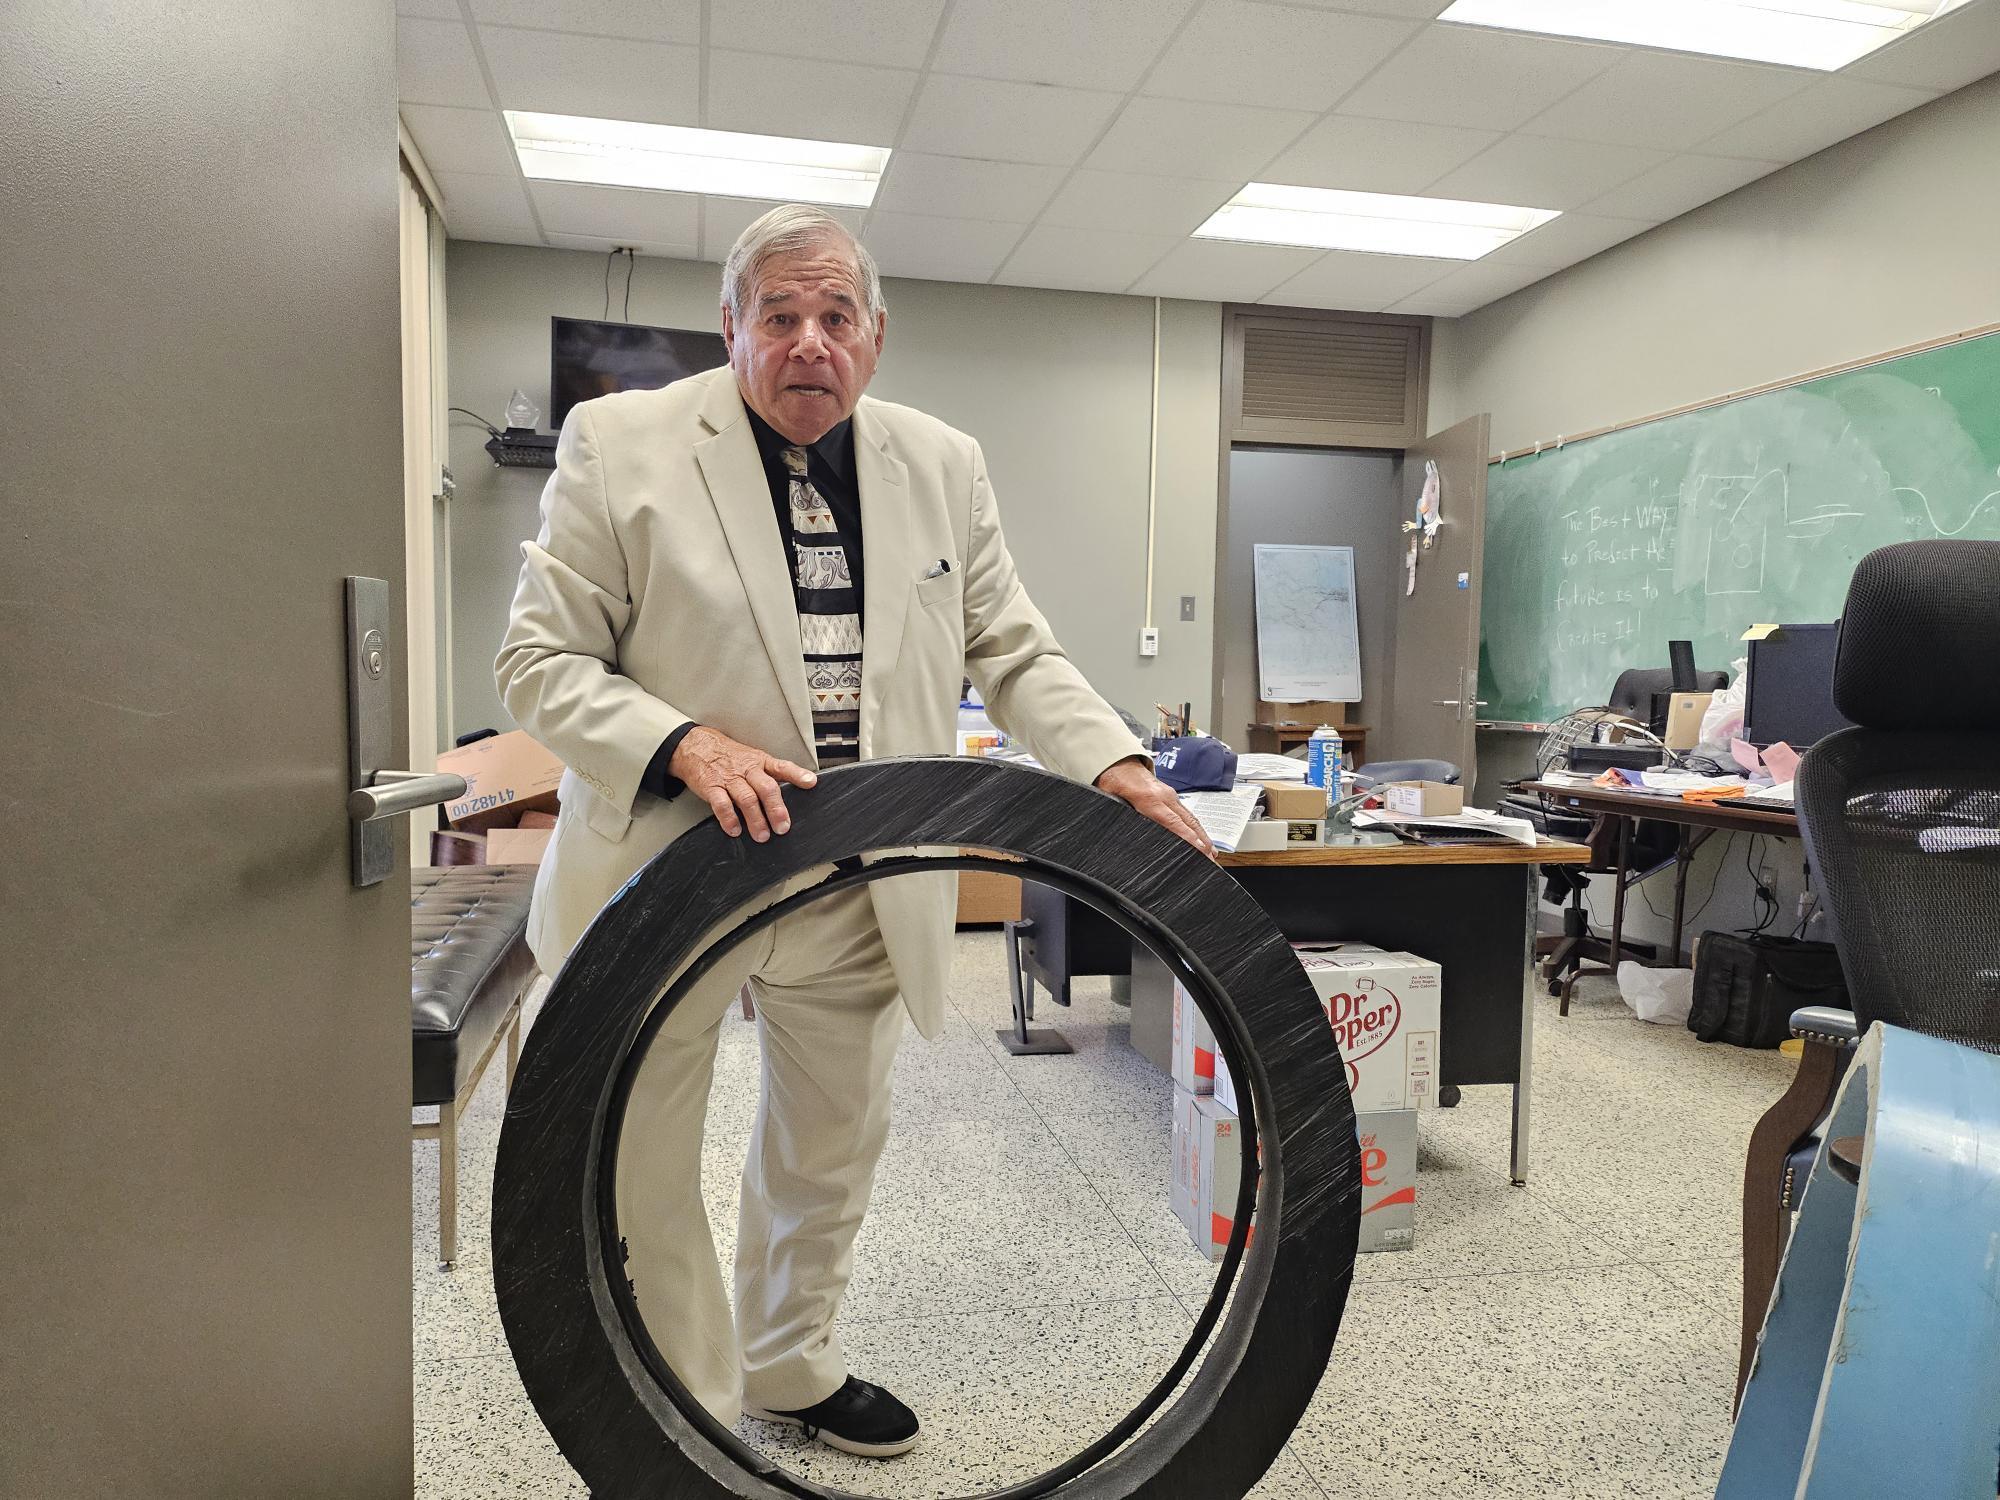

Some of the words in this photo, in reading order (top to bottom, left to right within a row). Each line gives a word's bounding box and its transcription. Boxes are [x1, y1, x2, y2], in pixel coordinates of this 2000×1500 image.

[1641, 575, 1659, 600] to
[1328, 992, 1368, 1026] Dr
[1321, 1003, 1393, 1051] pper
[1368, 1031, 1383, 1043] 1885
[1216, 1123, 1232, 1133] 24
[1360, 1132, 1377, 1147] iet
